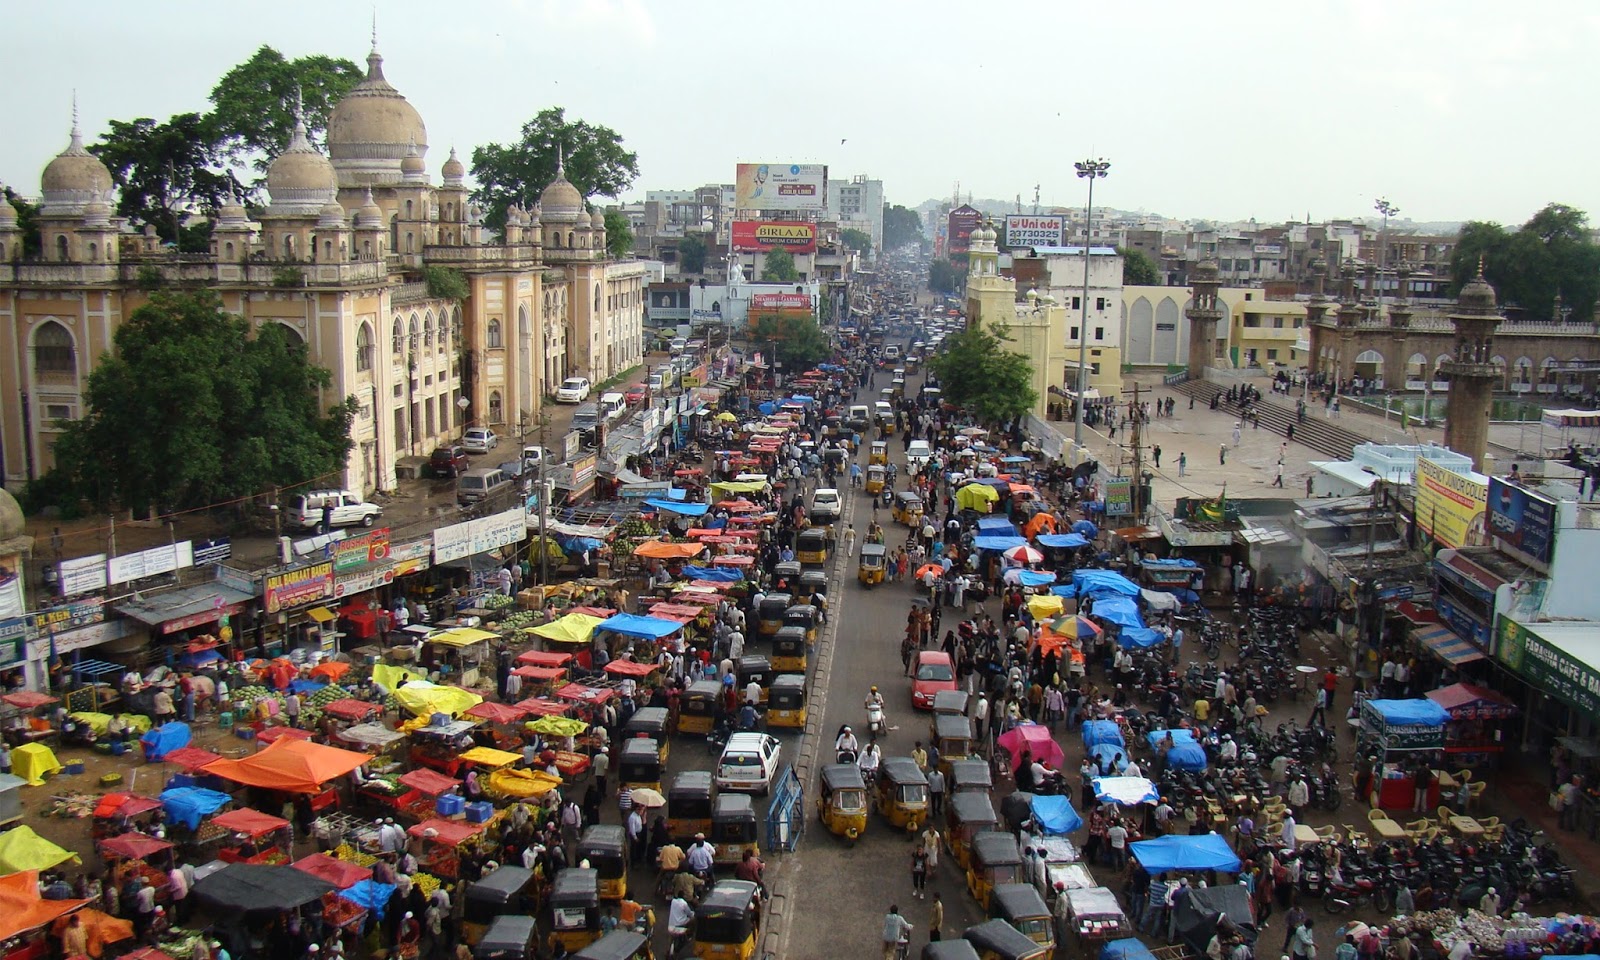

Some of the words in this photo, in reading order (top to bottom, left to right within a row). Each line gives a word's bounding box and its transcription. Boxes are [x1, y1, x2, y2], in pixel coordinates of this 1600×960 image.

[759, 228, 793, 236] BIRLA
[1008, 230, 1060, 238] 23730325
[1491, 509, 1516, 534] PEPSI
[1525, 636, 1558, 670] FARASHA
[1558, 657, 1580, 682] CAFE
[1587, 675, 1600, 697] BA
